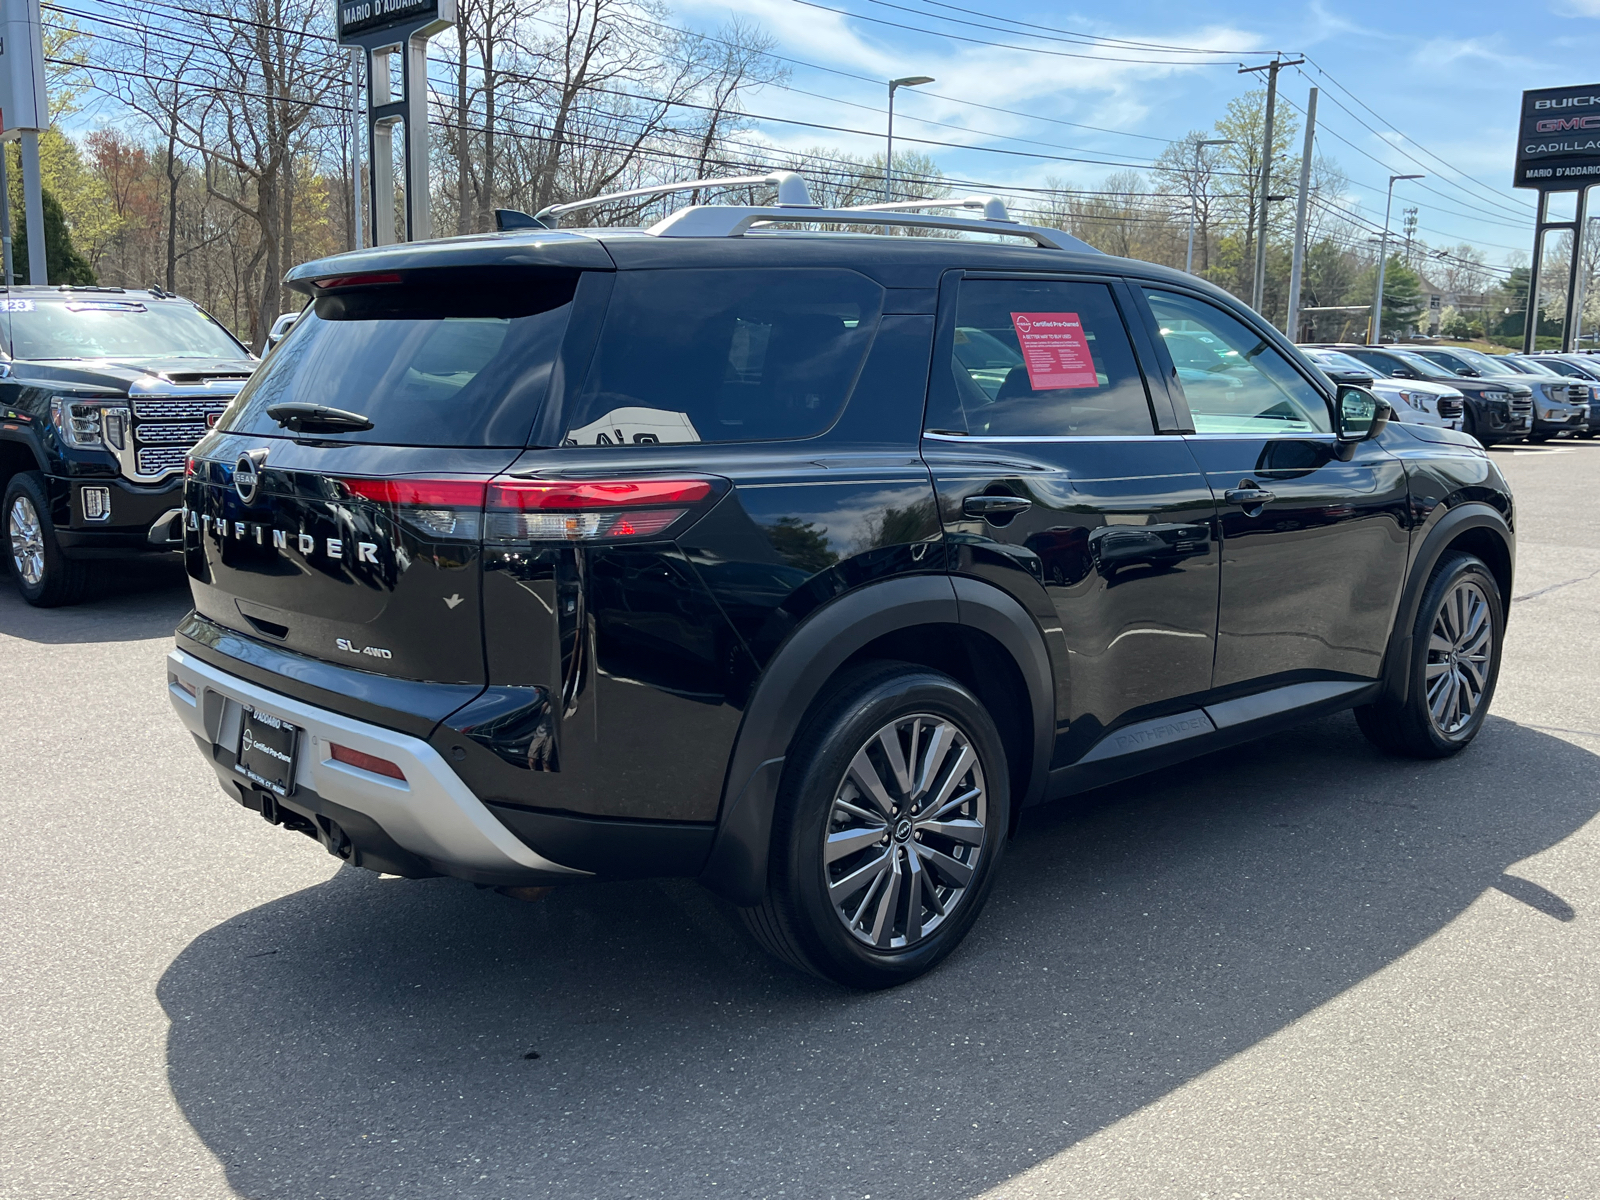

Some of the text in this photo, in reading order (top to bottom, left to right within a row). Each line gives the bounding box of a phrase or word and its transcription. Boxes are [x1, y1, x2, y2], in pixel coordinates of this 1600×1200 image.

[343, 0, 422, 25] MARIO D'ADDA
[1534, 96, 1600, 110] BUICK
[1536, 115, 1600, 133] GMC
[1526, 165, 1600, 178] MARIO D'ADDARIO
[336, 638, 392, 659] SL 4WD
[1115, 716, 1210, 749] PATHFINDER
[253, 740, 270, 753] Certified
